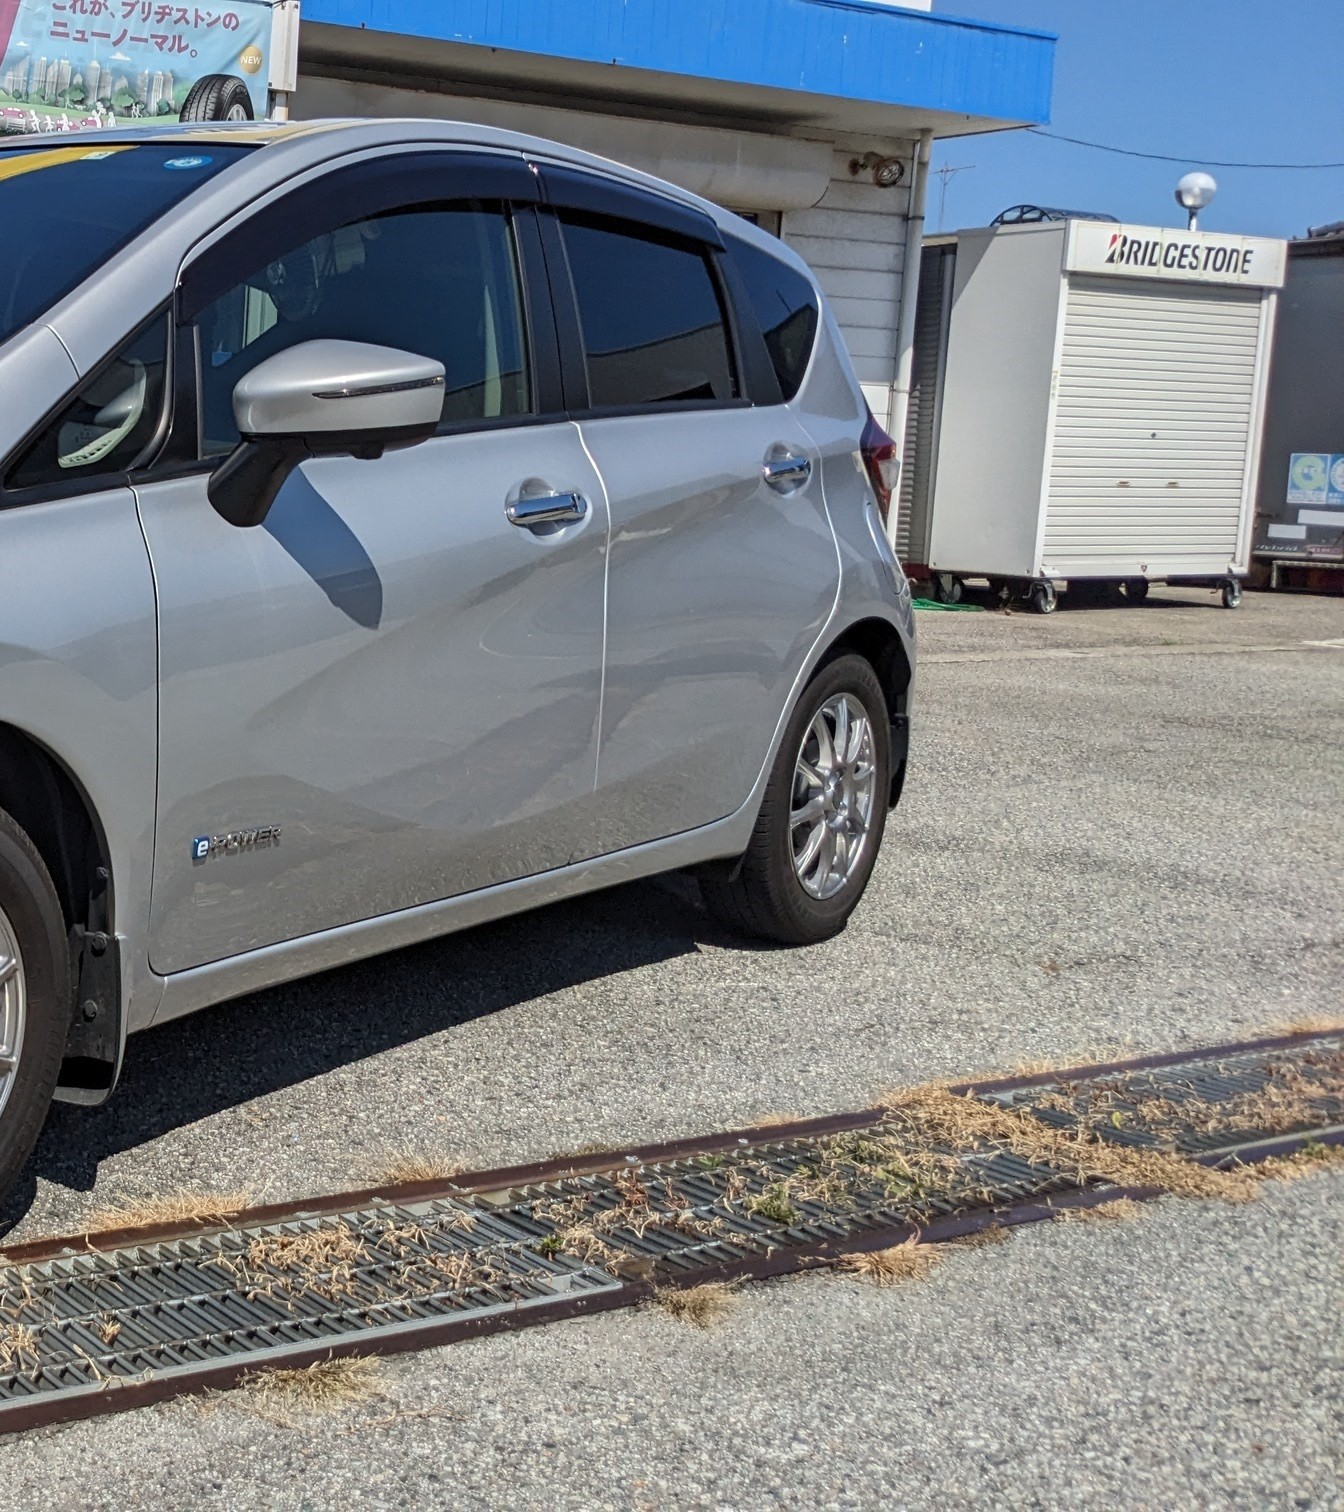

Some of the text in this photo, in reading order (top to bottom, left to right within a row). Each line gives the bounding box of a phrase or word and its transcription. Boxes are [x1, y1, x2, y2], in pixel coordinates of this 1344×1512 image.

[50, 21, 198, 58] ニューノーマル。
[240, 55, 261, 65] NEW
[1105, 234, 1254, 274] BRIDGESTONE
